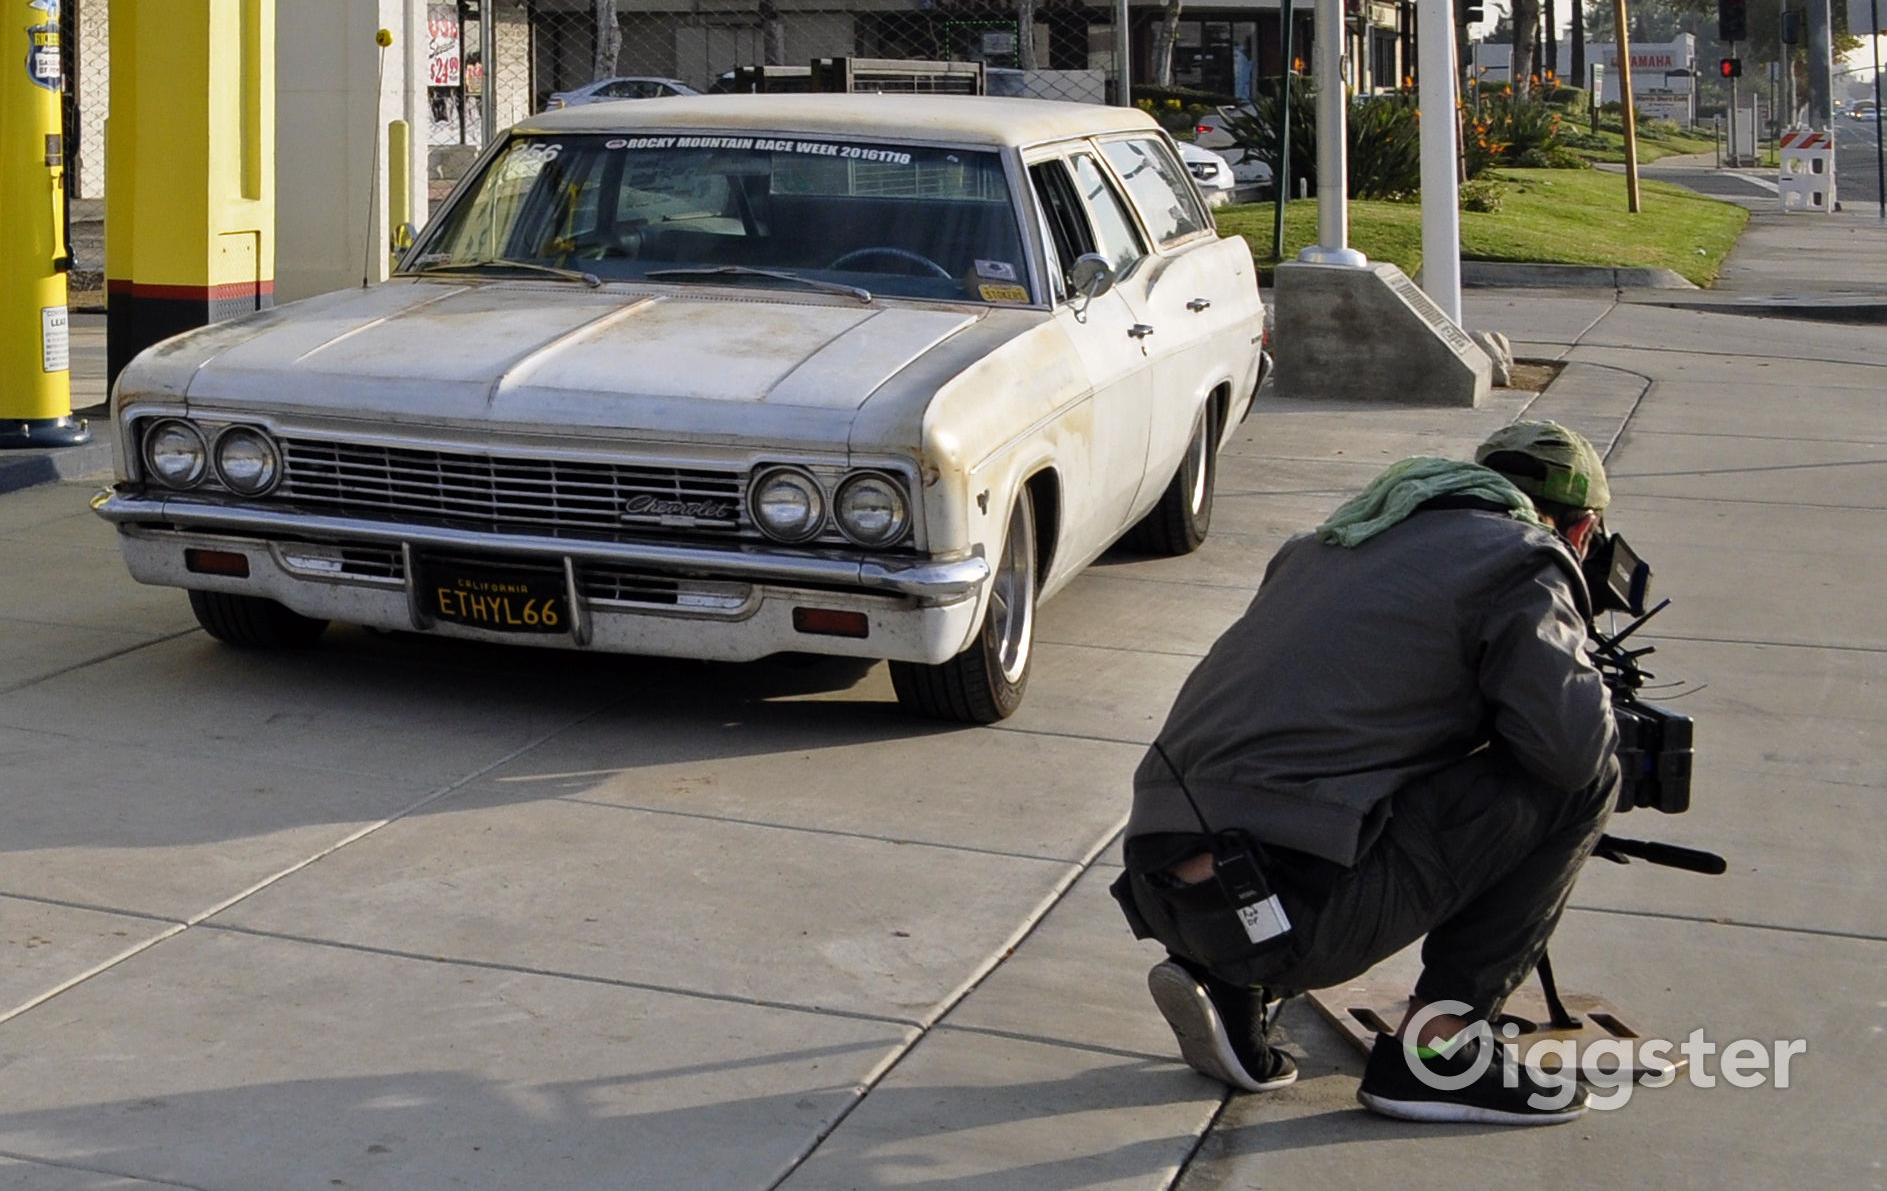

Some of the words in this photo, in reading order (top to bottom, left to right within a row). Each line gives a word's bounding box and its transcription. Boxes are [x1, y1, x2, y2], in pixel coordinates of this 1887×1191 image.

[1631, 55, 1672, 67] AMAHA
[626, 137, 676, 149] ROCKY
[677, 137, 753, 150] MOUNTAIN
[755, 138, 794, 153] RACE
[795, 141, 840, 157] WEEK
[626, 494, 729, 518] Chevrolet
[457, 577, 529, 594] CALIFORNIA
[437, 588, 559, 626] ETHYL66
